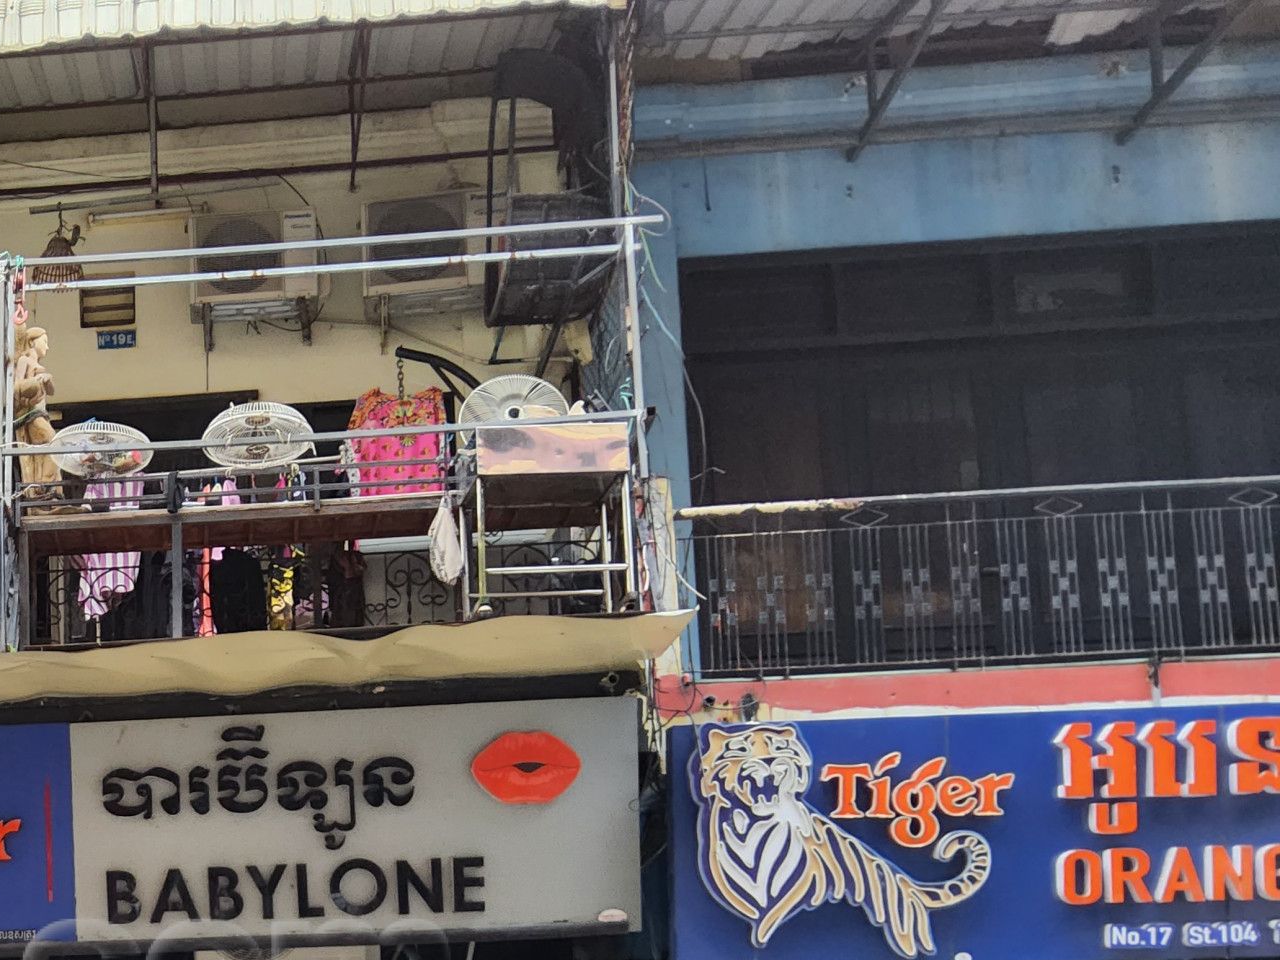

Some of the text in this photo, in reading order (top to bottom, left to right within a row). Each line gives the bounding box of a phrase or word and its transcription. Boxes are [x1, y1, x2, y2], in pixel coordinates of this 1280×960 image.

[821, 751, 1015, 847] Tiger
[105, 856, 486, 925] BABYLONE
[1107, 923, 1173, 947] No.17
[1185, 921, 1259, 946] St.104
